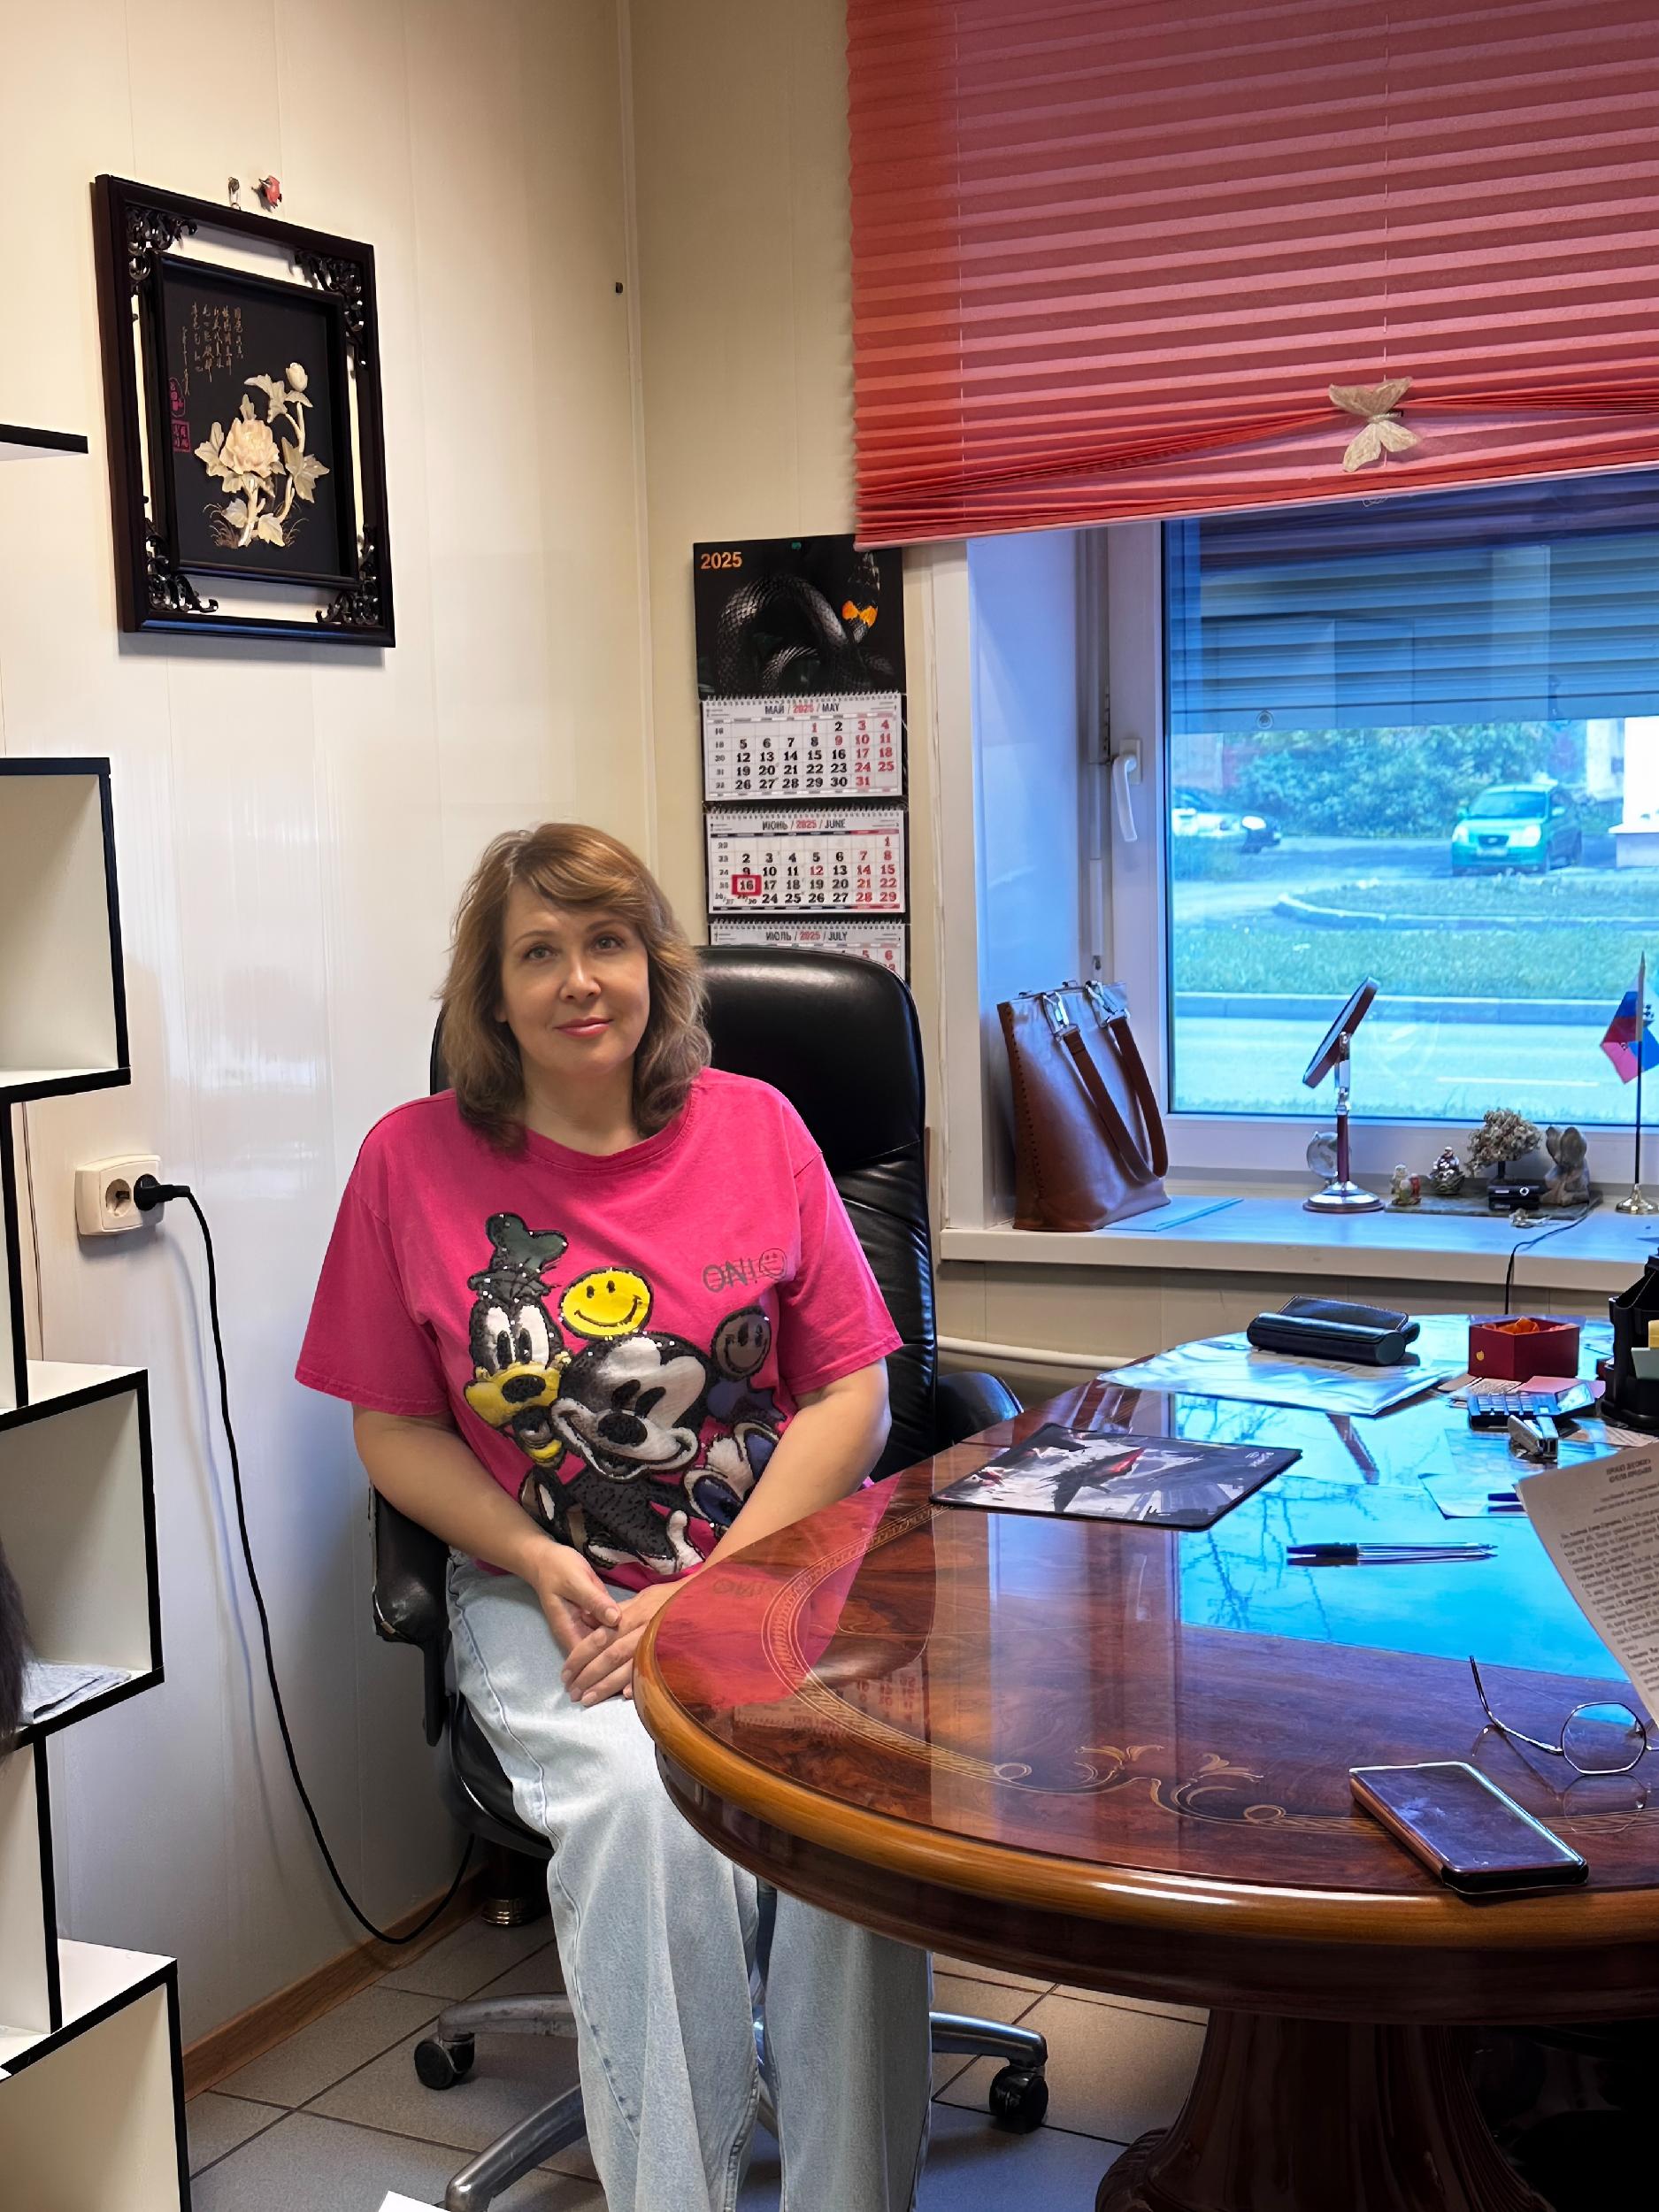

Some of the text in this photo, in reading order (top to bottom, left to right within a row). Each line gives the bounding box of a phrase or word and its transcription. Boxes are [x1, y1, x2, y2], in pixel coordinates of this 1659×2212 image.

[701, 552, 742, 570] 2025
[765, 704, 784, 714] МАЙ
[793, 704, 814, 713] 2025
[822, 703, 840, 712] MAY
[812, 723, 817, 733] 1
[835, 721, 842, 732] 2
[858, 720, 865, 731] 3
[881, 719, 889, 729] 4
[740, 739, 747, 749] 5
[763, 738, 771, 748] 6
[787, 738, 795, 747] 7
[811, 737, 818, 747] 8
[835, 735, 842, 745] 9
[856, 734, 870, 745] 10
[880, 733, 890, 743] 11
[737, 753, 750, 763] 12
[761, 752, 774, 762] 13
[784, 751, 797, 761] 14
[808, 750, 822, 760] 15
[833, 749, 846, 759] 16
[856, 748, 869, 758] 17
[879, 747, 892, 757] 18
[737, 766, 750, 776] 19
[759, 765, 775, 775] 20
[784, 764, 797, 774] 21
[806, 764, 823, 774] 22
[831, 763, 847, 773] 23
[855, 762, 871, 772] 24
[878, 761, 894, 772] 25
[735, 780, 751, 789] 26
[759, 779, 776, 788] 27
[782, 779, 799, 788] 28
[806, 778, 823, 787] 29
[831, 777, 848, 787] 30
[856, 777, 870, 786] 31
[763, 820, 787, 830] ИЮНЬ
[795, 820, 817, 829] 2025
[825, 819, 846, 829] JUNE
[885, 837, 889, 847] 1
[742, 854, 750, 863] 2
[766, 853, 772, 863] 3
[788, 853, 796, 863] 4
[813, 852, 820, 862] 5
[836, 852, 843, 862] 6
[860, 851, 867, 861] 7
[884, 850, 892, 860] 8
[763, 867, 776, 876] 10
[787, 866, 798, 876] 11
[810, 865, 823, 875] 12
[833, 865, 847, 875] 13
[857, 865, 871, 875] 14
[881, 864, 895, 874] 15
[740, 880, 754, 890] 16
[764, 880, 777, 890] 17
[787, 879, 800, 889] 18
[810, 879, 824, 889] 19
[833, 879, 849, 888] 20
[857, 878, 871, 888] 21
[880, 878, 896, 887] 22
[763, 894, 778, 903] 24
[785, 894, 802, 903] 25
[809, 893, 825, 902] 26
[833, 893, 849, 902] 27
[856, 892, 872, 902] 28
[880, 892, 896, 902] 29
[766, 932, 792, 941] ИЮЛЬ
[800, 931, 820, 941] 2025
[828, 931, 848, 941] JULY
[885, 949, 893, 960] 6
